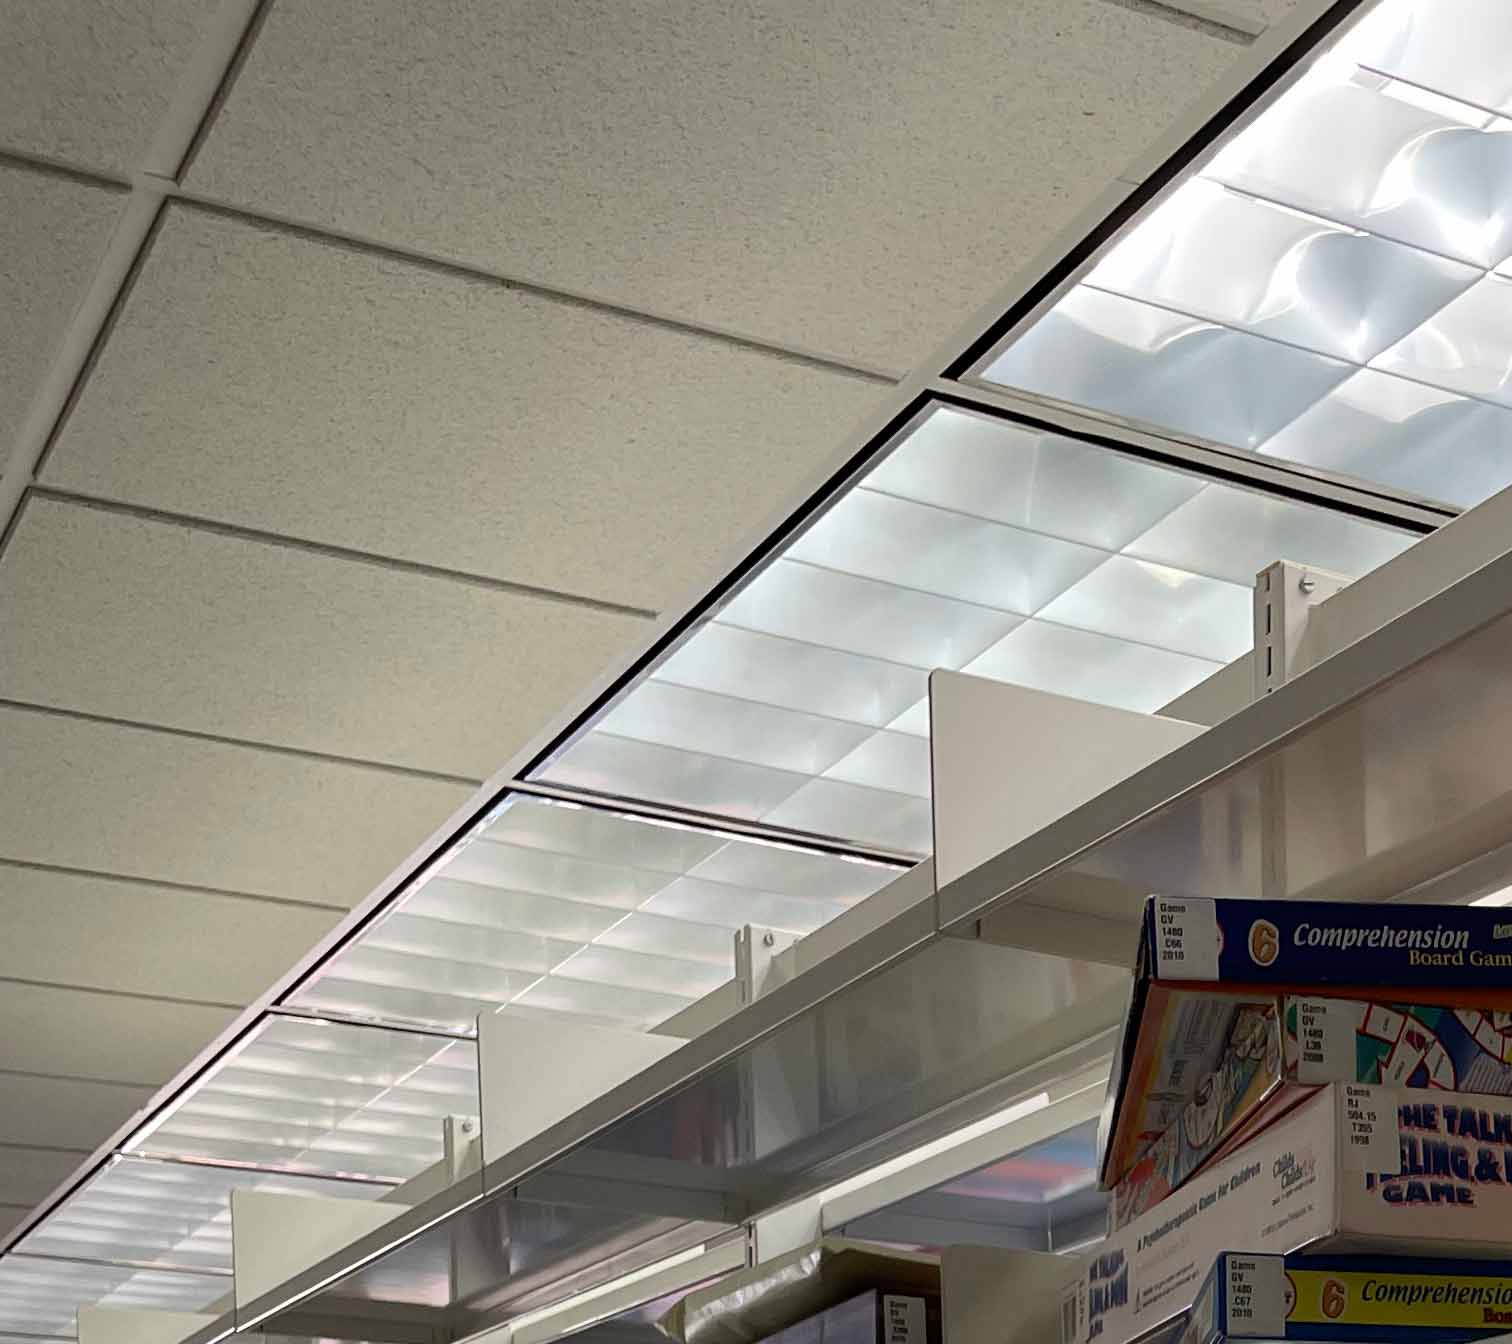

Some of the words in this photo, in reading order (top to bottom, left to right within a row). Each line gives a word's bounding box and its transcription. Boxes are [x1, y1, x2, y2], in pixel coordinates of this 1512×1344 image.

[1160, 915, 1174, 925] GV
[1248, 919, 1280, 966] 6
[1293, 922, 1470, 953] Comprehension
[1408, 948, 1465, 967] Board
[1346, 1086, 1371, 1098] Game
[1229, 1161, 1262, 1192] Children
[1474, 1148, 1504, 1184] &
[1382, 1181, 1476, 1206] GAME
[1230, 1260, 1255, 1271] Game
[1231, 1272, 1244, 1282] GV
[1322, 1280, 1346, 1319] 6
